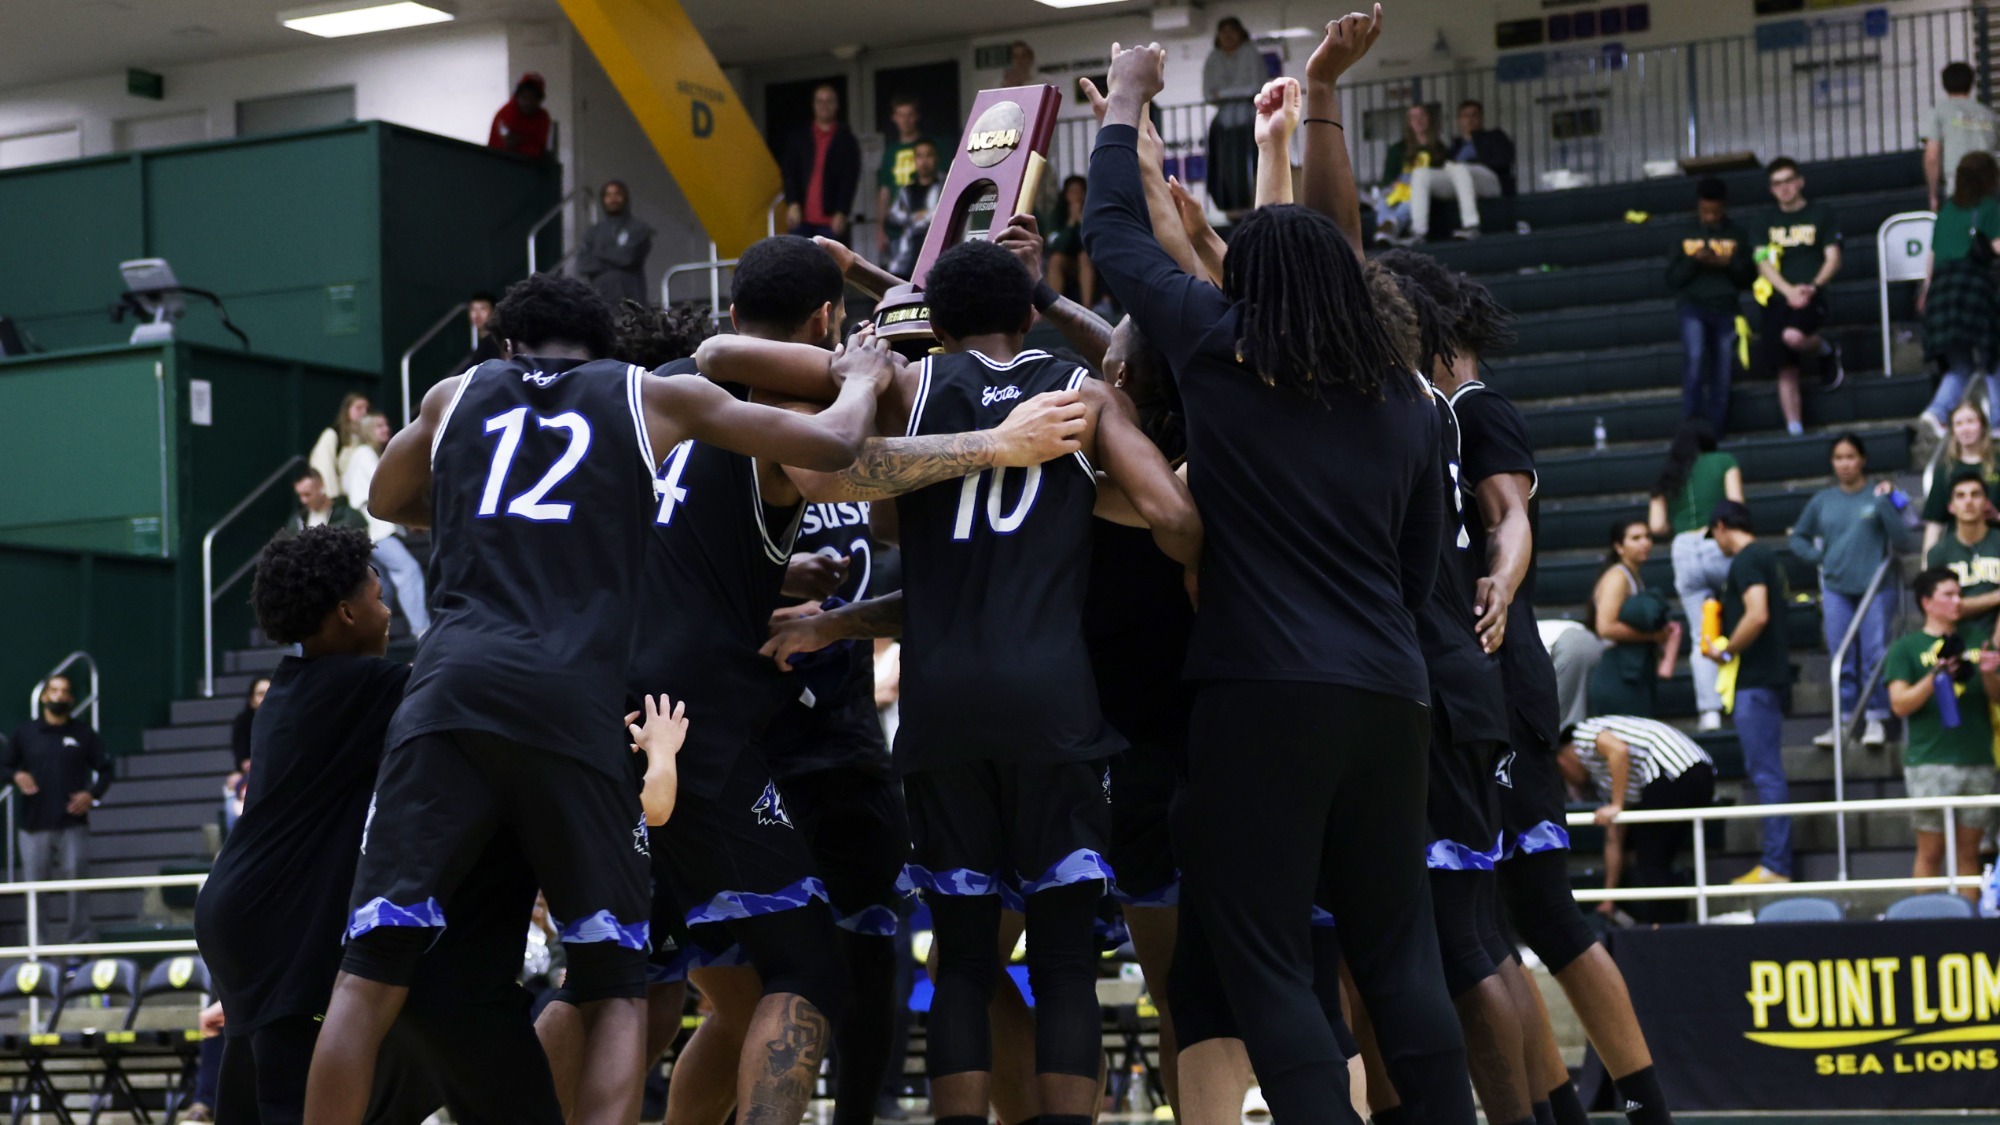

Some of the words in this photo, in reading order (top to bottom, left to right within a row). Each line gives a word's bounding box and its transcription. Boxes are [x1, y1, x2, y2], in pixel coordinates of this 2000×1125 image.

[692, 100, 714, 138] D
[967, 129, 1019, 152] NCAA
[1907, 239, 1923, 257] D
[885, 308, 919, 324] REGIONAL
[981, 384, 1023, 406] Yotes
[475, 404, 593, 523] 12
[652, 439, 695, 527] 4
[951, 463, 1045, 543] 10
[1745, 957, 1900, 1028] POINT
[1815, 1053, 1884, 1075] SEA
[1894, 1048, 1999, 1073] LIONS
